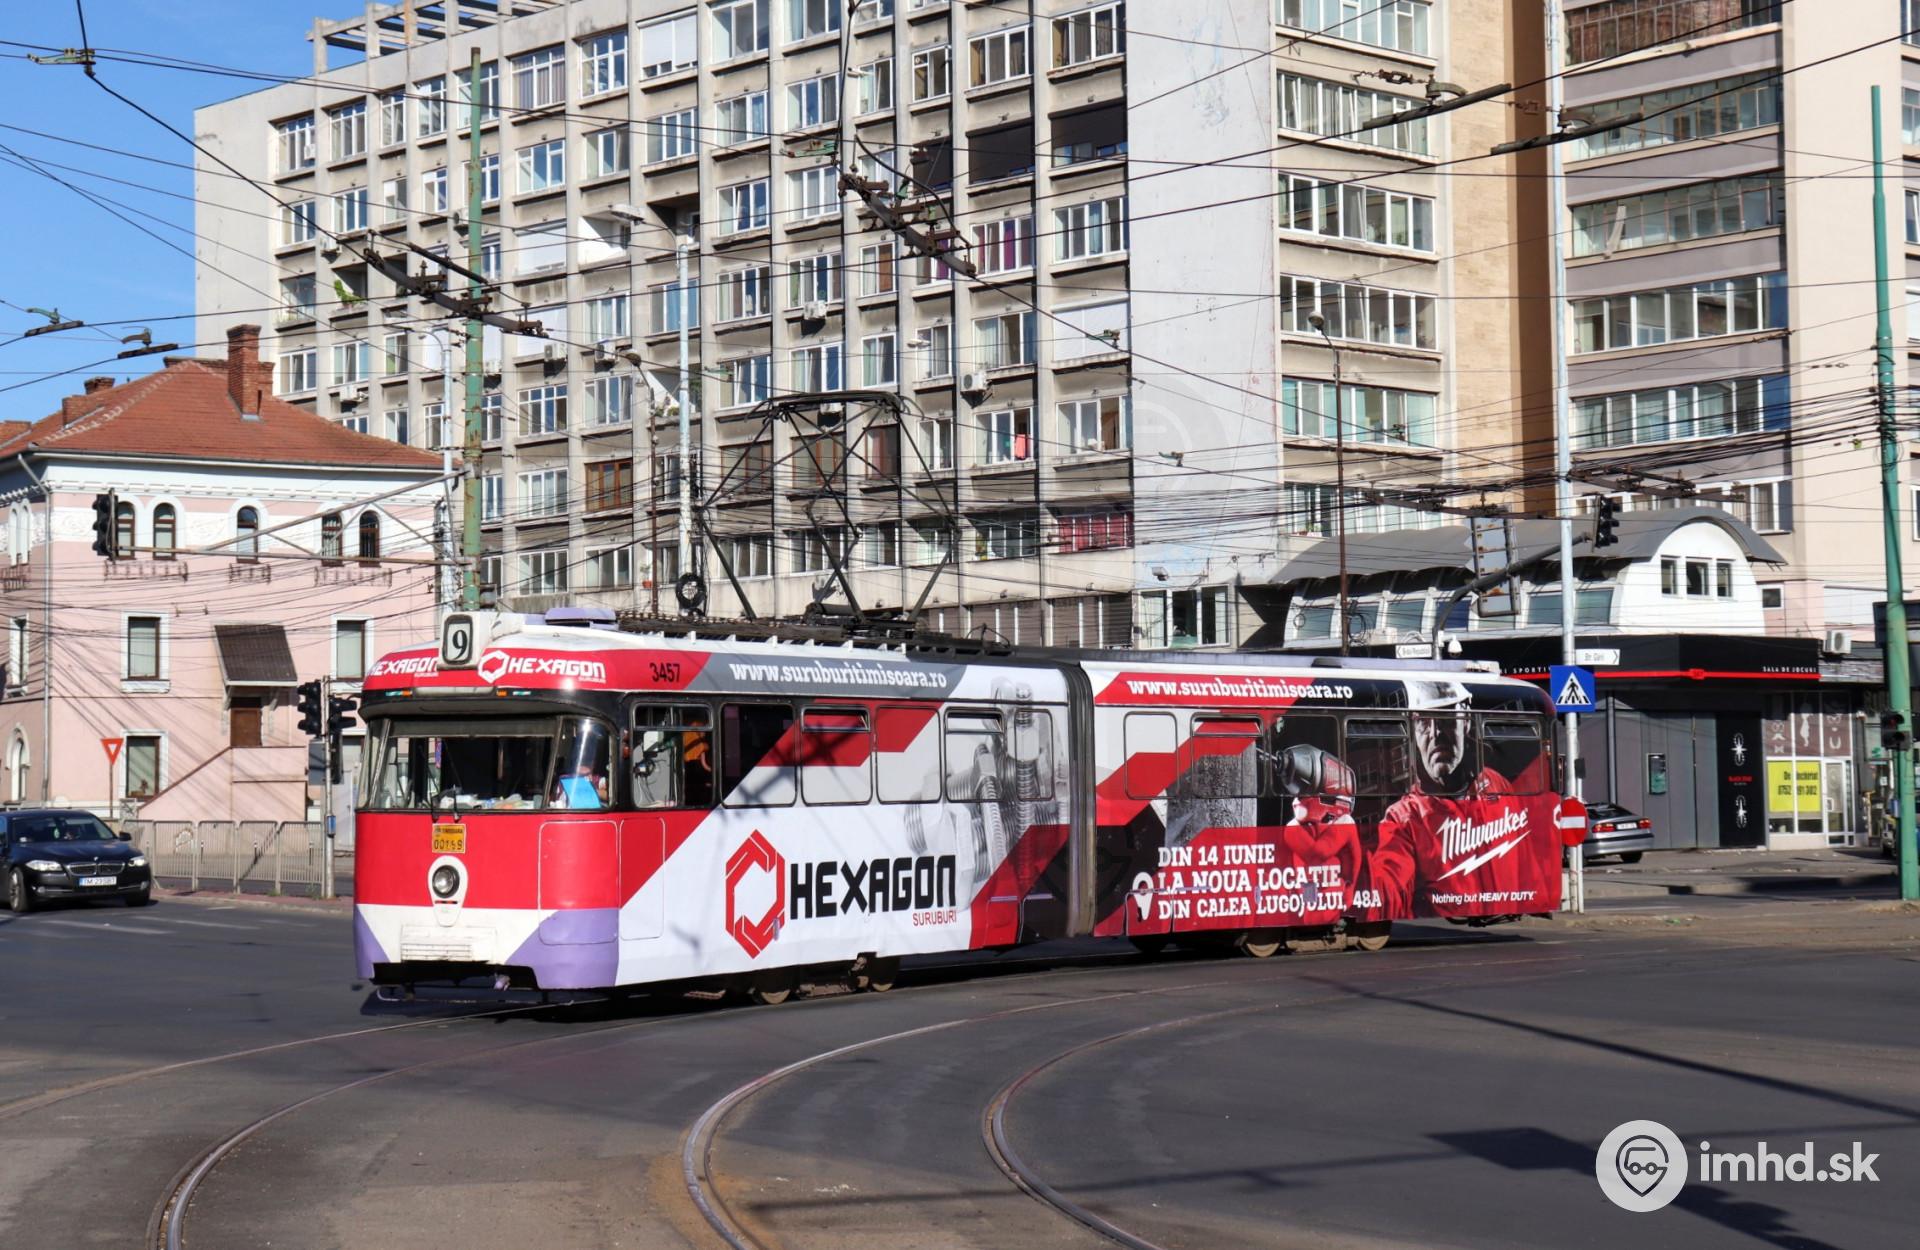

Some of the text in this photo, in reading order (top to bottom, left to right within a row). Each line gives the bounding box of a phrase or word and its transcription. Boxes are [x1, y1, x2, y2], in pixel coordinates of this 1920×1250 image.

[452, 629, 468, 660] 9
[509, 657, 606, 679] HEXAGON
[649, 662, 681, 683] 3457
[729, 660, 947, 688] www.suruburitimisoara.ro
[1127, 677, 1354, 699] www.suruburitimisoara.ro
[1436, 806, 1528, 864] Milwaukee
[1158, 844, 1275, 867] DIN 14 IUNIE
[790, 855, 956, 920] HEXAGON
[1158, 871, 1187, 895] LA
[1191, 869, 1252, 894] NOUA
[1158, 899, 1191, 919] DIN
[1197, 896, 1251, 918] CALEA
[1352, 890, 1382, 909] 48A
[1432, 893, 1462, 905] Nothing
[1464, 892, 1477, 903] but
[1479, 892, 1509, 902] HEAVY
[912, 910, 957, 926] SURUBURI
